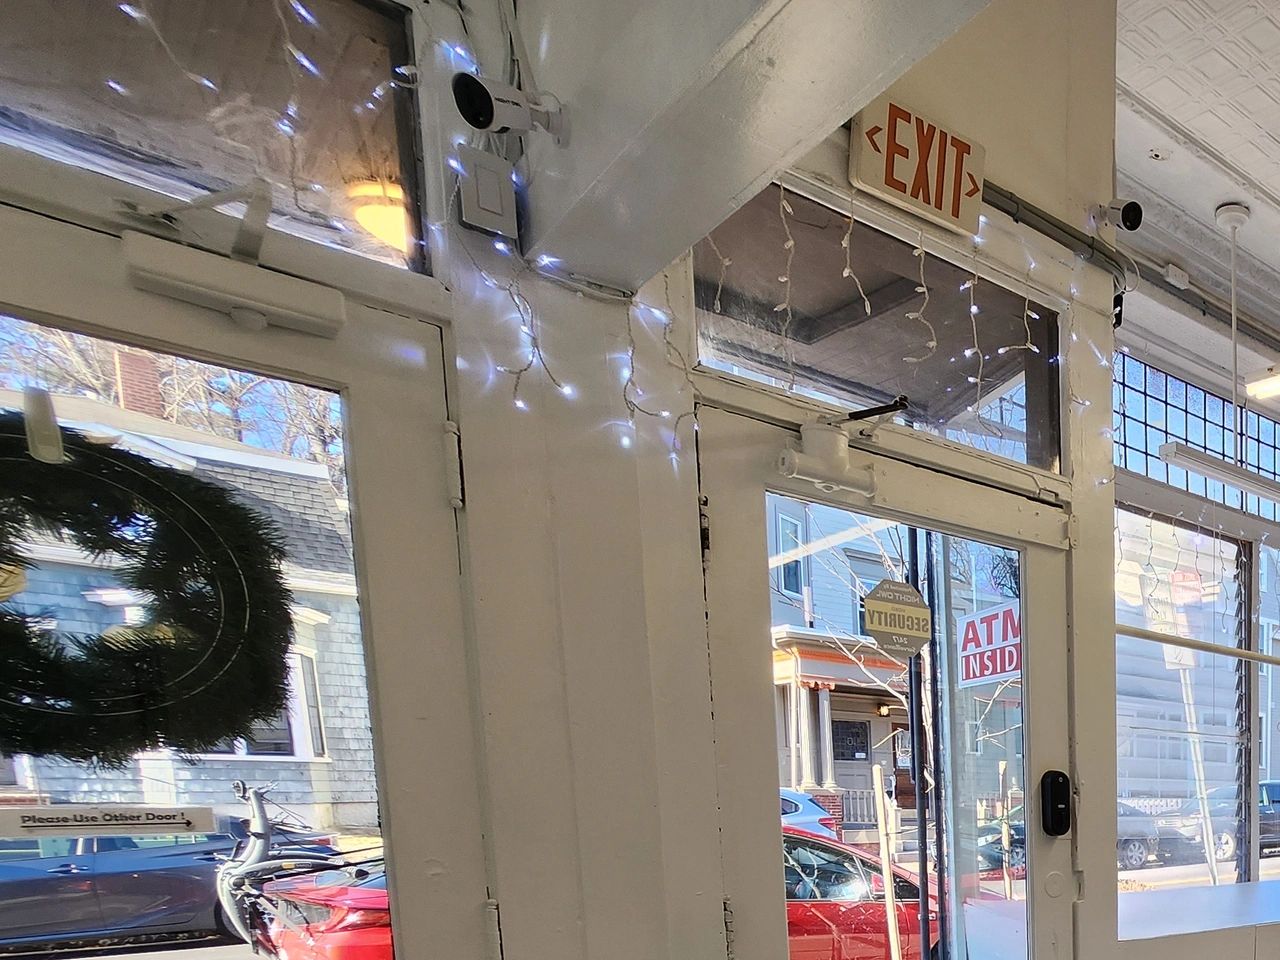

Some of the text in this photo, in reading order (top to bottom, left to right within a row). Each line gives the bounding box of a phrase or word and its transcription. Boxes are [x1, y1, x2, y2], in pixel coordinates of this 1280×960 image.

[884, 102, 971, 219] EXIT
[961, 608, 1020, 652] ATM
[21, 814, 69, 824] Please
[73, 814, 99, 823] Use
[103, 813, 141, 823] Other
[146, 812, 177, 821] Door
